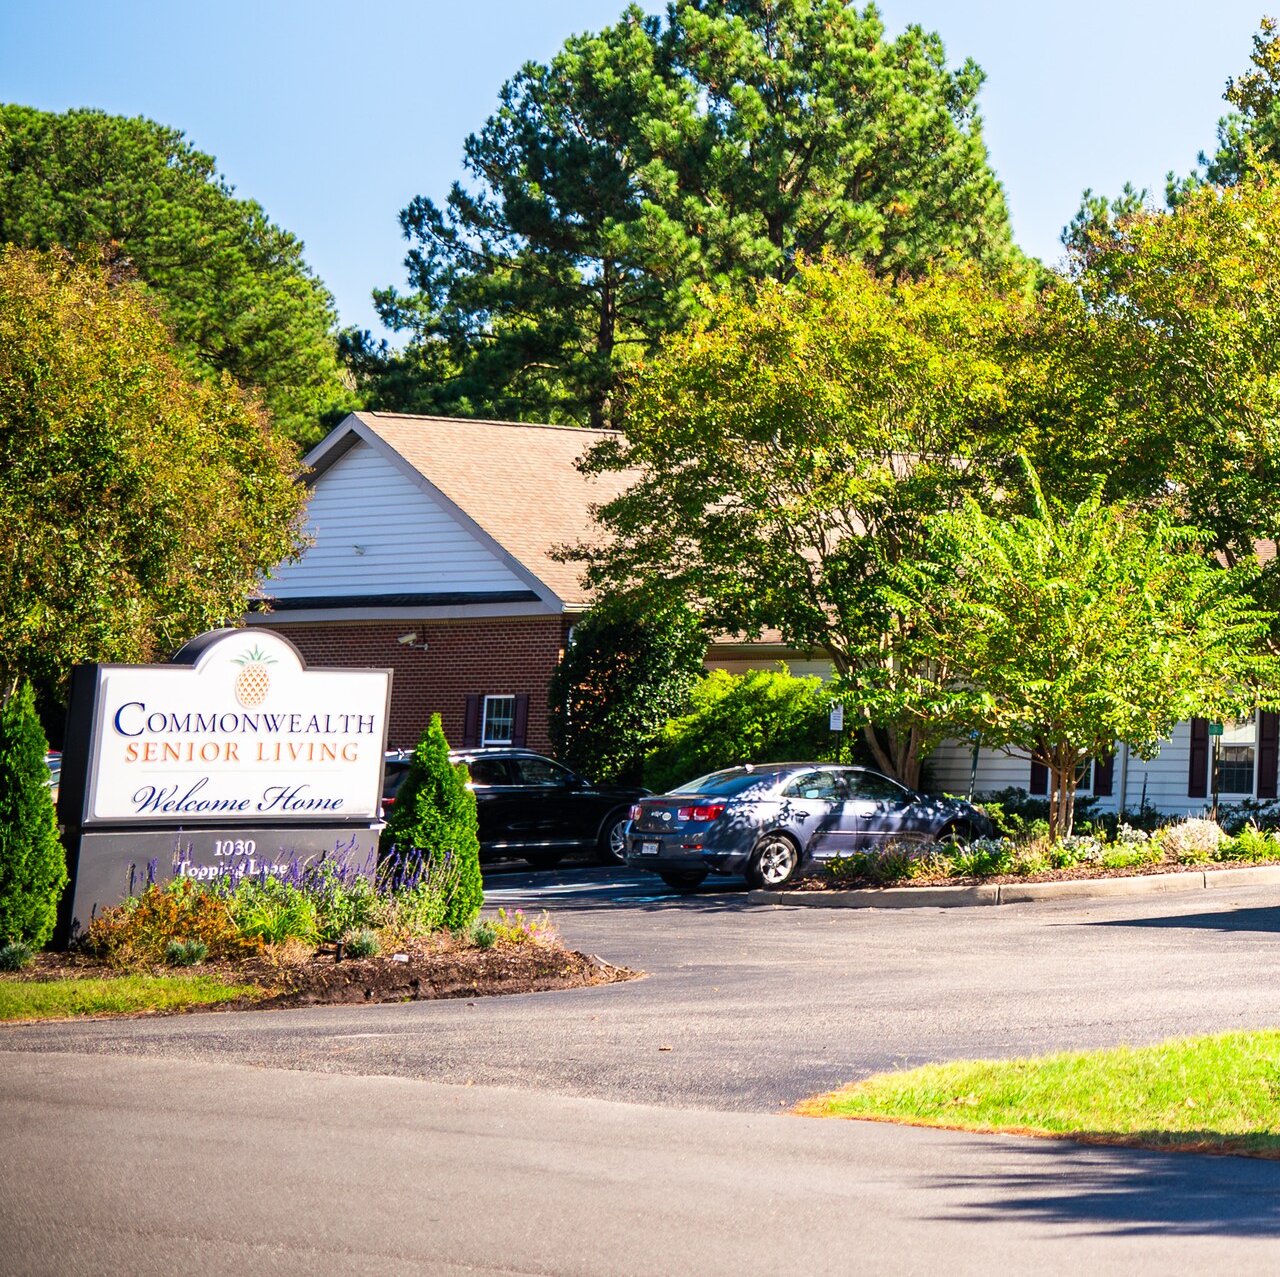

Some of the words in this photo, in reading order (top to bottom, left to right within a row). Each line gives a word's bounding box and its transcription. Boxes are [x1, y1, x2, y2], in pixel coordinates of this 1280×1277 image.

[114, 702, 375, 737] COMMONWEALTH
[125, 742, 239, 762] SENIOR
[256, 742, 359, 762] LIVING
[132, 777, 251, 814] Welcome
[257, 784, 344, 813] Home
[214, 839, 256, 856] 1030
